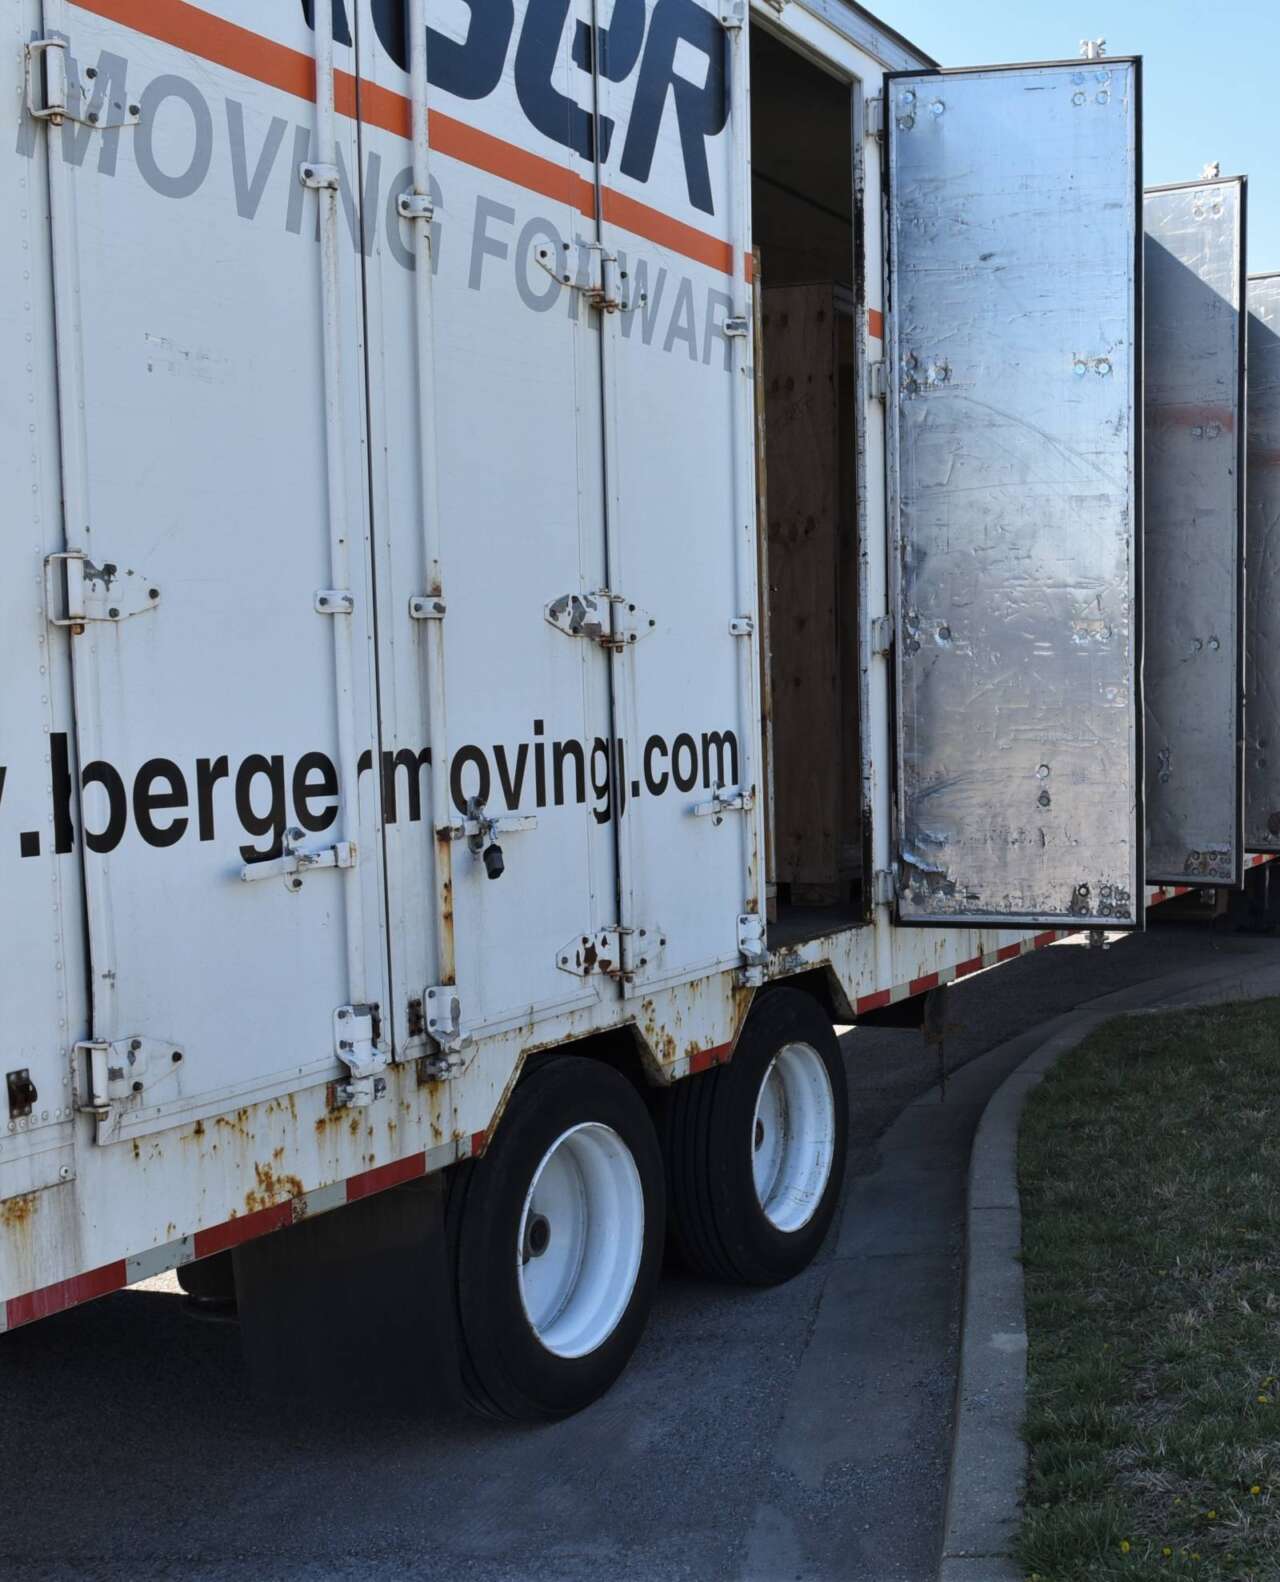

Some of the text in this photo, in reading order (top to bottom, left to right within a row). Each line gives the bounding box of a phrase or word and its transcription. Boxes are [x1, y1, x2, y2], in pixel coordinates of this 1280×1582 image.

[16, 28, 752, 379] MOVING FORWAR
[0, 719, 738, 864] .bergermoving.com
